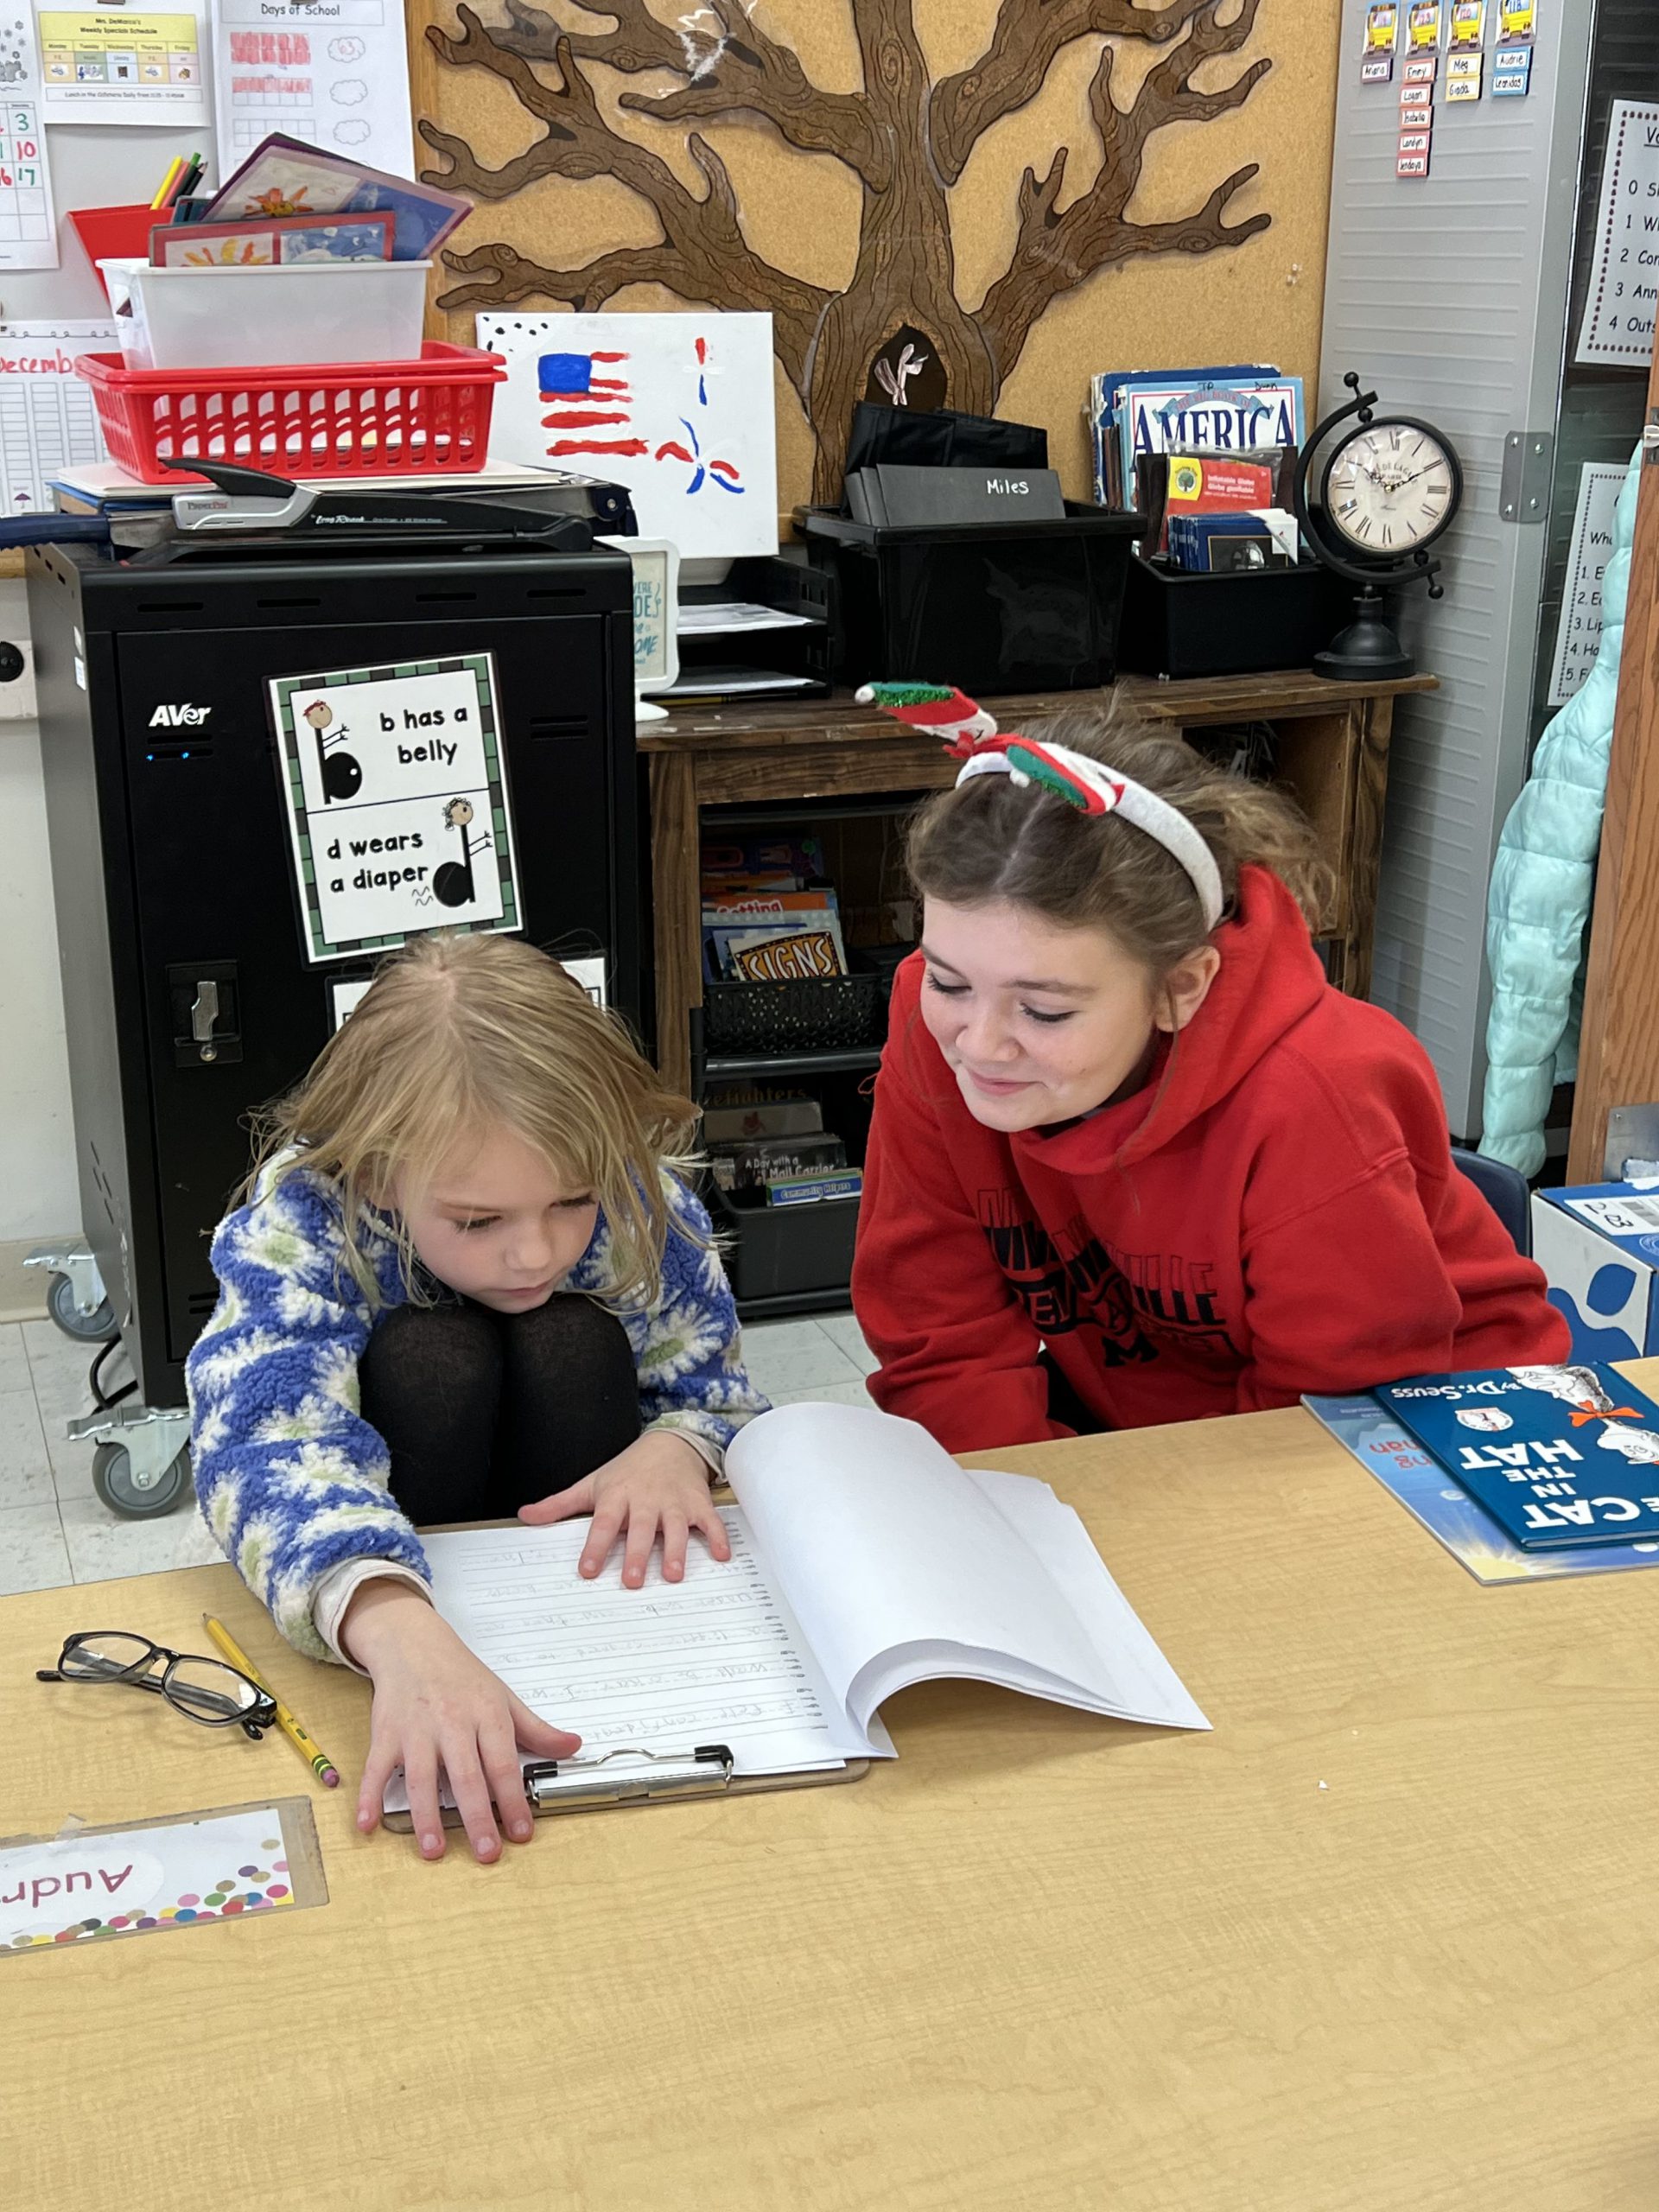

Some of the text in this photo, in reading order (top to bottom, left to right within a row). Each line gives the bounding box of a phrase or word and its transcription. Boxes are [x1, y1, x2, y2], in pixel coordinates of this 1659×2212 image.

[261, 3, 340, 17] Days of School
[1453, 60, 1469, 74] Meg
[15, 113, 29, 131] 3
[16, 141, 36, 161] 10
[18, 168, 35, 186] 17
[1628, 180, 1637, 194] 0
[1626, 215, 1632, 229] 1
[1620, 249, 1629, 263] 2
[1615, 283, 1623, 296] 3
[1609, 315, 1618, 330] 4
[1130, 399, 1294, 472] AMERICA
[987, 479, 1029, 495] Miles
[149, 703, 212, 727] AVer
[379, 708, 468, 732] b has a
[397, 740, 458, 766] belly
[327, 832, 424, 860] d wears
[330, 866, 429, 893] a diaper
[748, 937, 832, 981] SIGNS
[1390, 1385, 1465, 1401] Seuss
[1460, 1379, 1508, 1396] Dr.
[1459, 1439, 1585, 1471] HAT
[1501, 1466, 1577, 1483] THE
[1530, 1482, 1577, 1499] IN
[1522, 1497, 1642, 1529] CAT
[2, 1865, 133, 1908] Audr
